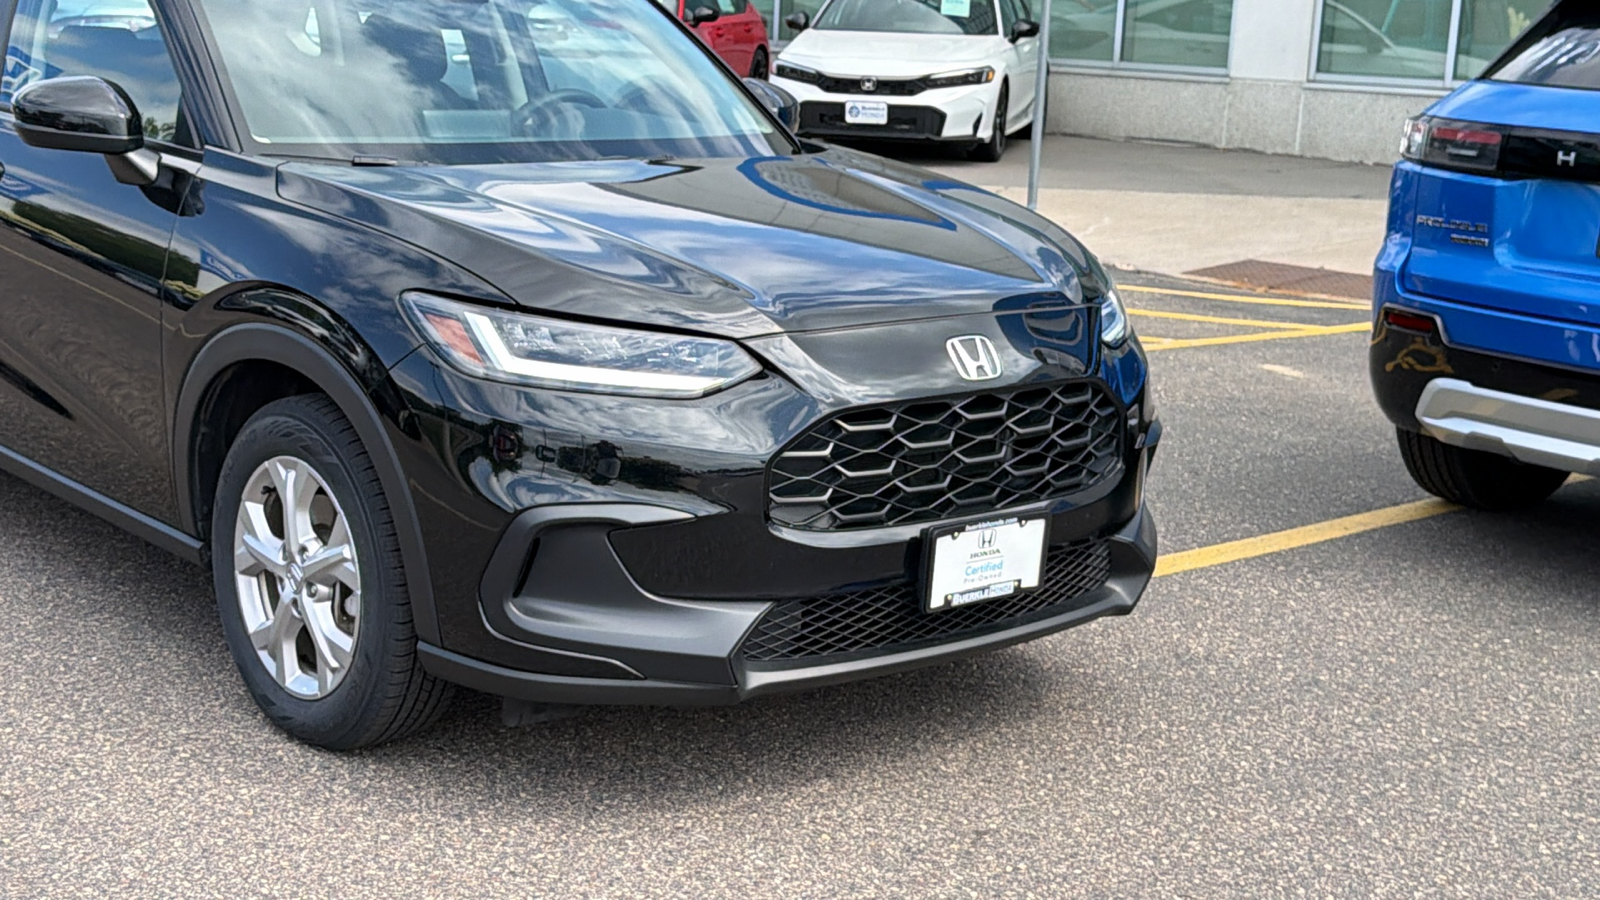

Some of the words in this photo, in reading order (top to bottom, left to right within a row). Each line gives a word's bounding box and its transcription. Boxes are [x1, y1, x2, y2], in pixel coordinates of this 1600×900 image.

[1557, 150, 1576, 167] H
[970, 548, 1001, 559] HONDA
[965, 560, 1003, 576] Certified
[963, 571, 1002, 585] Pre-Owned
[990, 583, 1012, 594] HONDA
